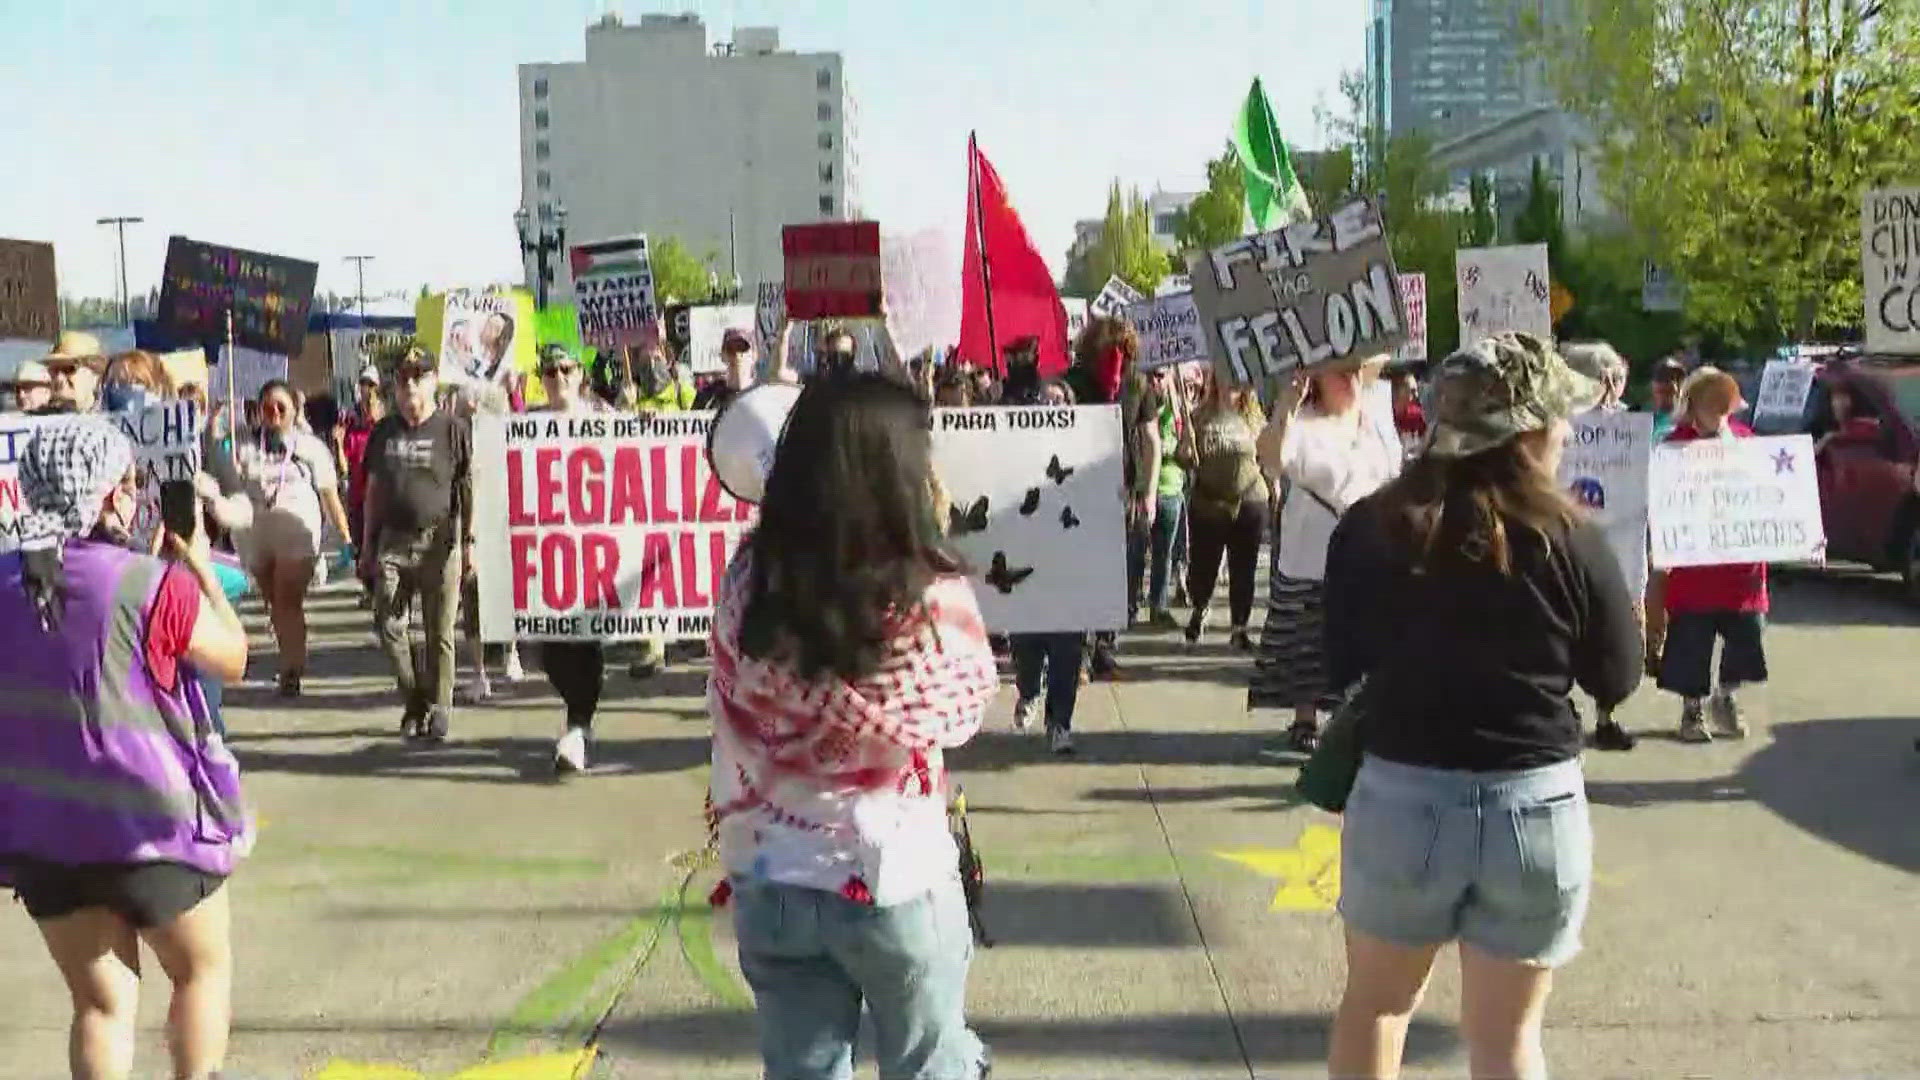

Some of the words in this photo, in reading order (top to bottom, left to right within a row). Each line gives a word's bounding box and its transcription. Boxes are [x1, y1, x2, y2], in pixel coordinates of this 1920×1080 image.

[1208, 198, 1383, 290] FIRE
[576, 274, 651, 293] STAND
[580, 290, 646, 309] WITH
[579, 305, 655, 331] PALESTINE
[1216, 263, 1400, 383] FELON
[119, 399, 196, 445] ACH!
[546, 419, 560, 438] A
[568, 418, 606, 438] LAS
[942, 411, 997, 431] PARA
[1006, 409, 1075, 429] TODXS!
[506, 445, 750, 526] LEGALIZ
[510, 532, 621, 611] FOR
[514, 615, 583, 636] PIERCE
[590, 614, 669, 635] COUNTY
